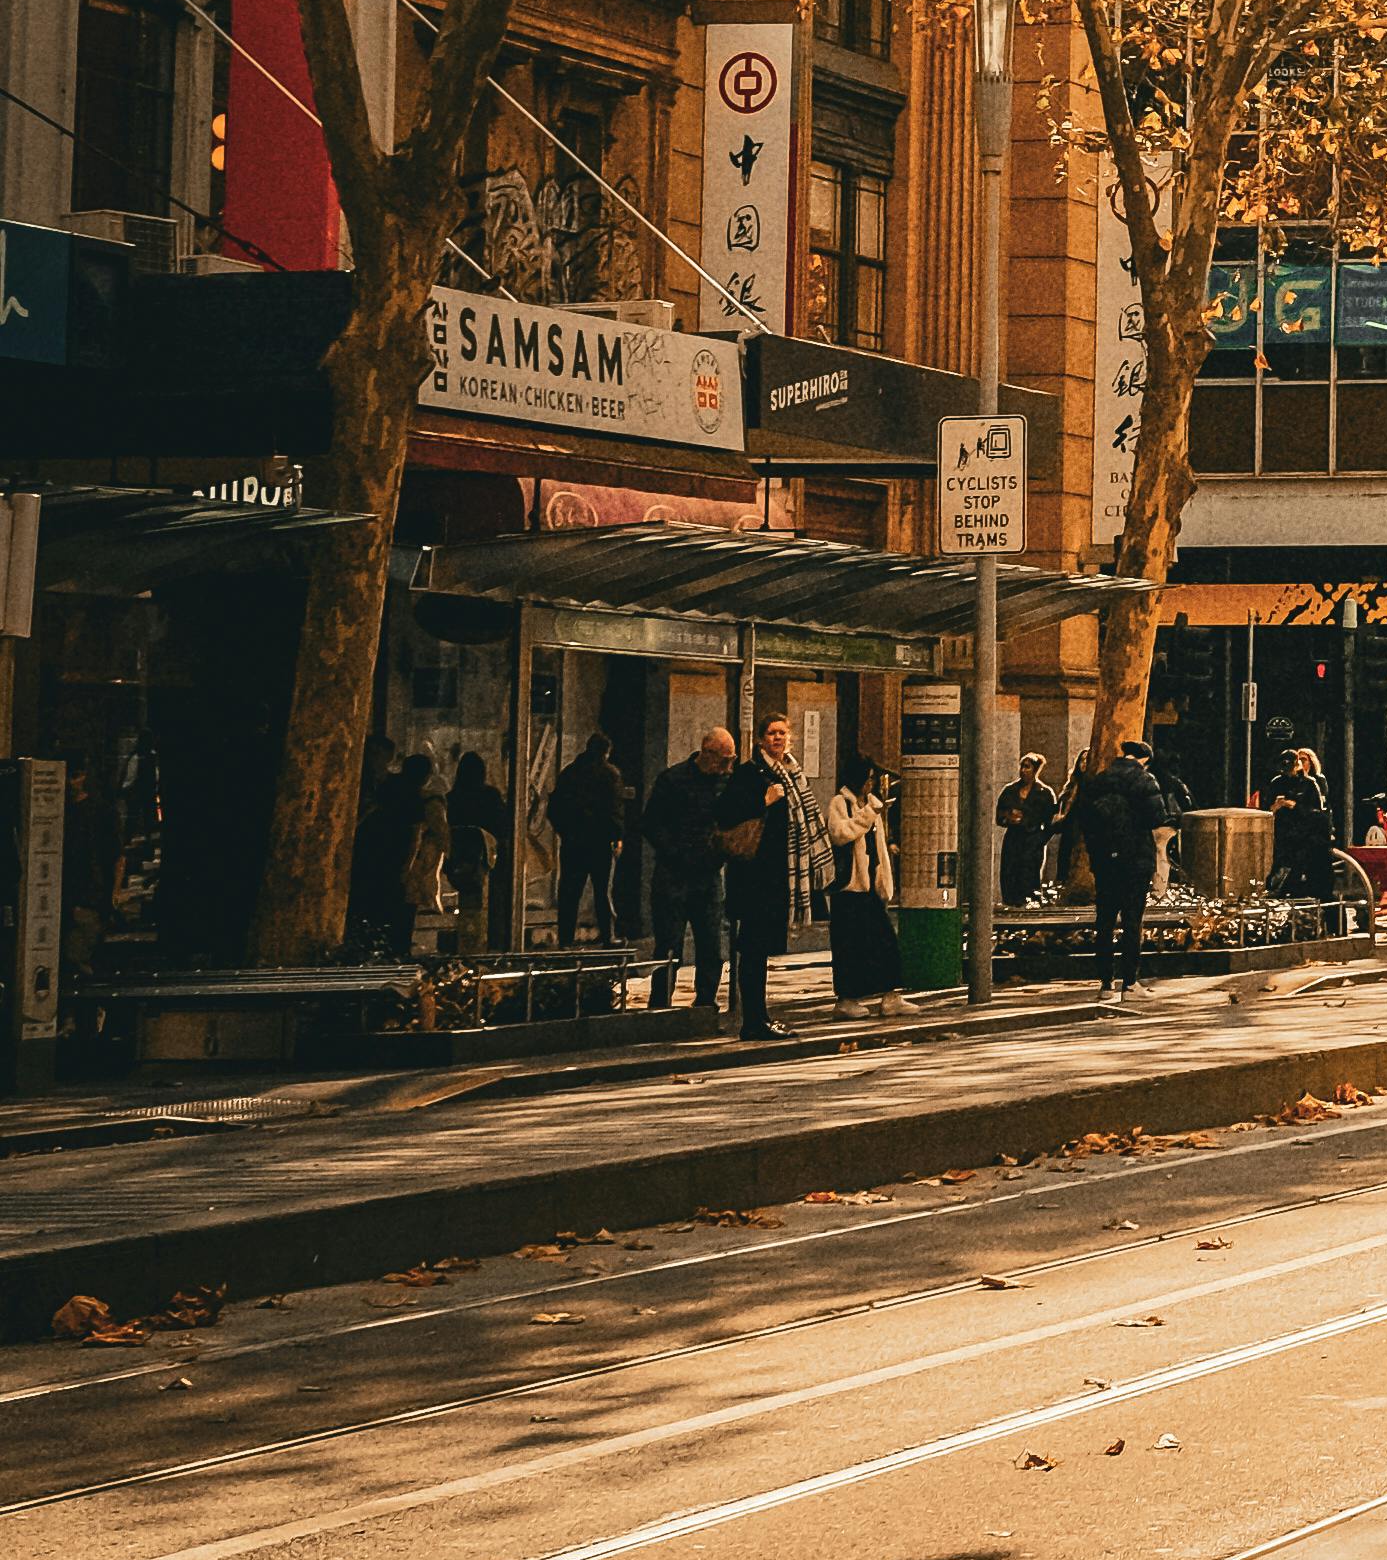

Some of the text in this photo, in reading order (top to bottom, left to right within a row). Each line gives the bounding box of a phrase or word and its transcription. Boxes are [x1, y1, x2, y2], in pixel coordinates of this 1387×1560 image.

[459, 307, 624, 386] SAMSAM
[460, 376, 518, 404] KOREAN
[524, 385, 583, 414] CHICKEN
[591, 396, 625, 421] BEER
[770, 371, 840, 411] SUPERHIRO
[946, 475, 1018, 491] CYCLISTS
[963, 495, 1001, 510] STOP
[954, 514, 1010, 528] BEHIND
[956, 532, 1008, 547] TRAMS
